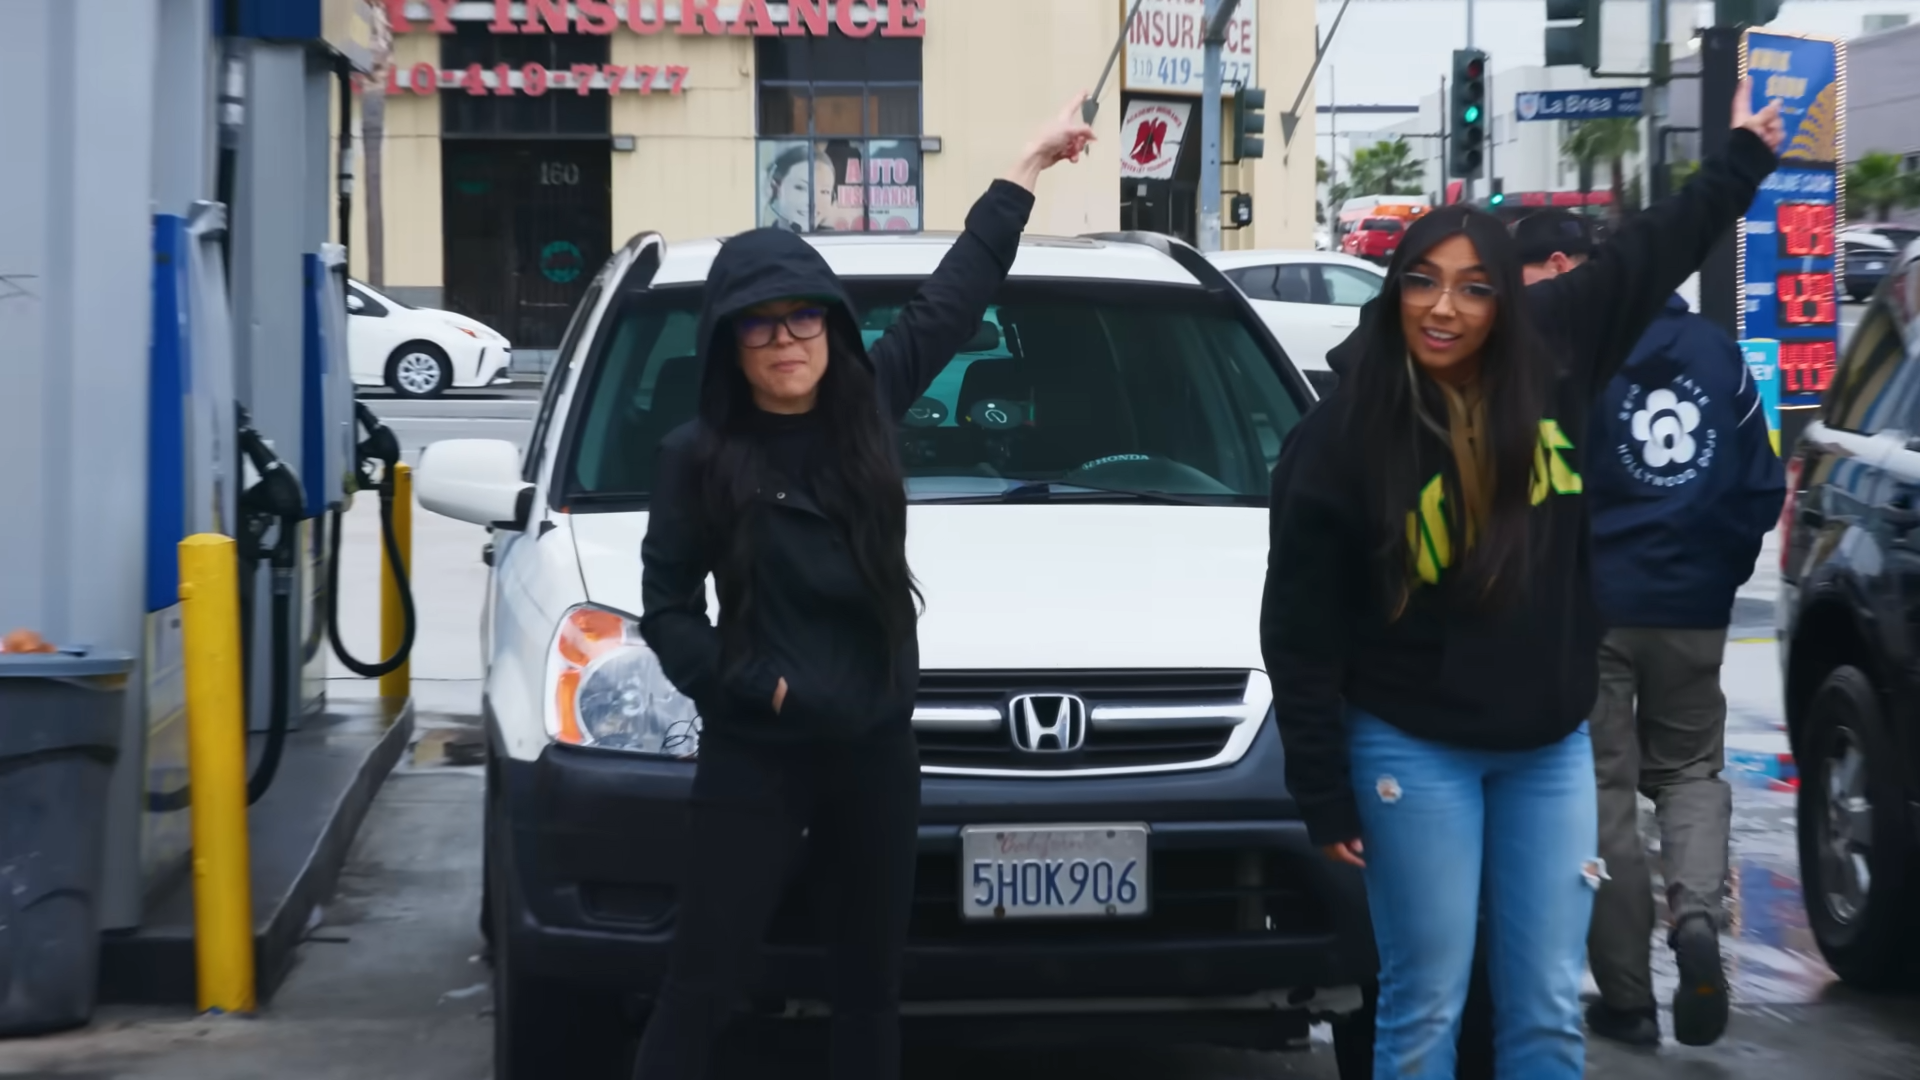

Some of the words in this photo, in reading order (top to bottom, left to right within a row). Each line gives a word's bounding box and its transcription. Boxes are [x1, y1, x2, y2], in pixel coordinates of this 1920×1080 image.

[487, 0, 928, 38] INSURANCE
[540, 162, 579, 185] 160
[844, 157, 909, 185] AUTO
[1095, 453, 1150, 466] HONDA
